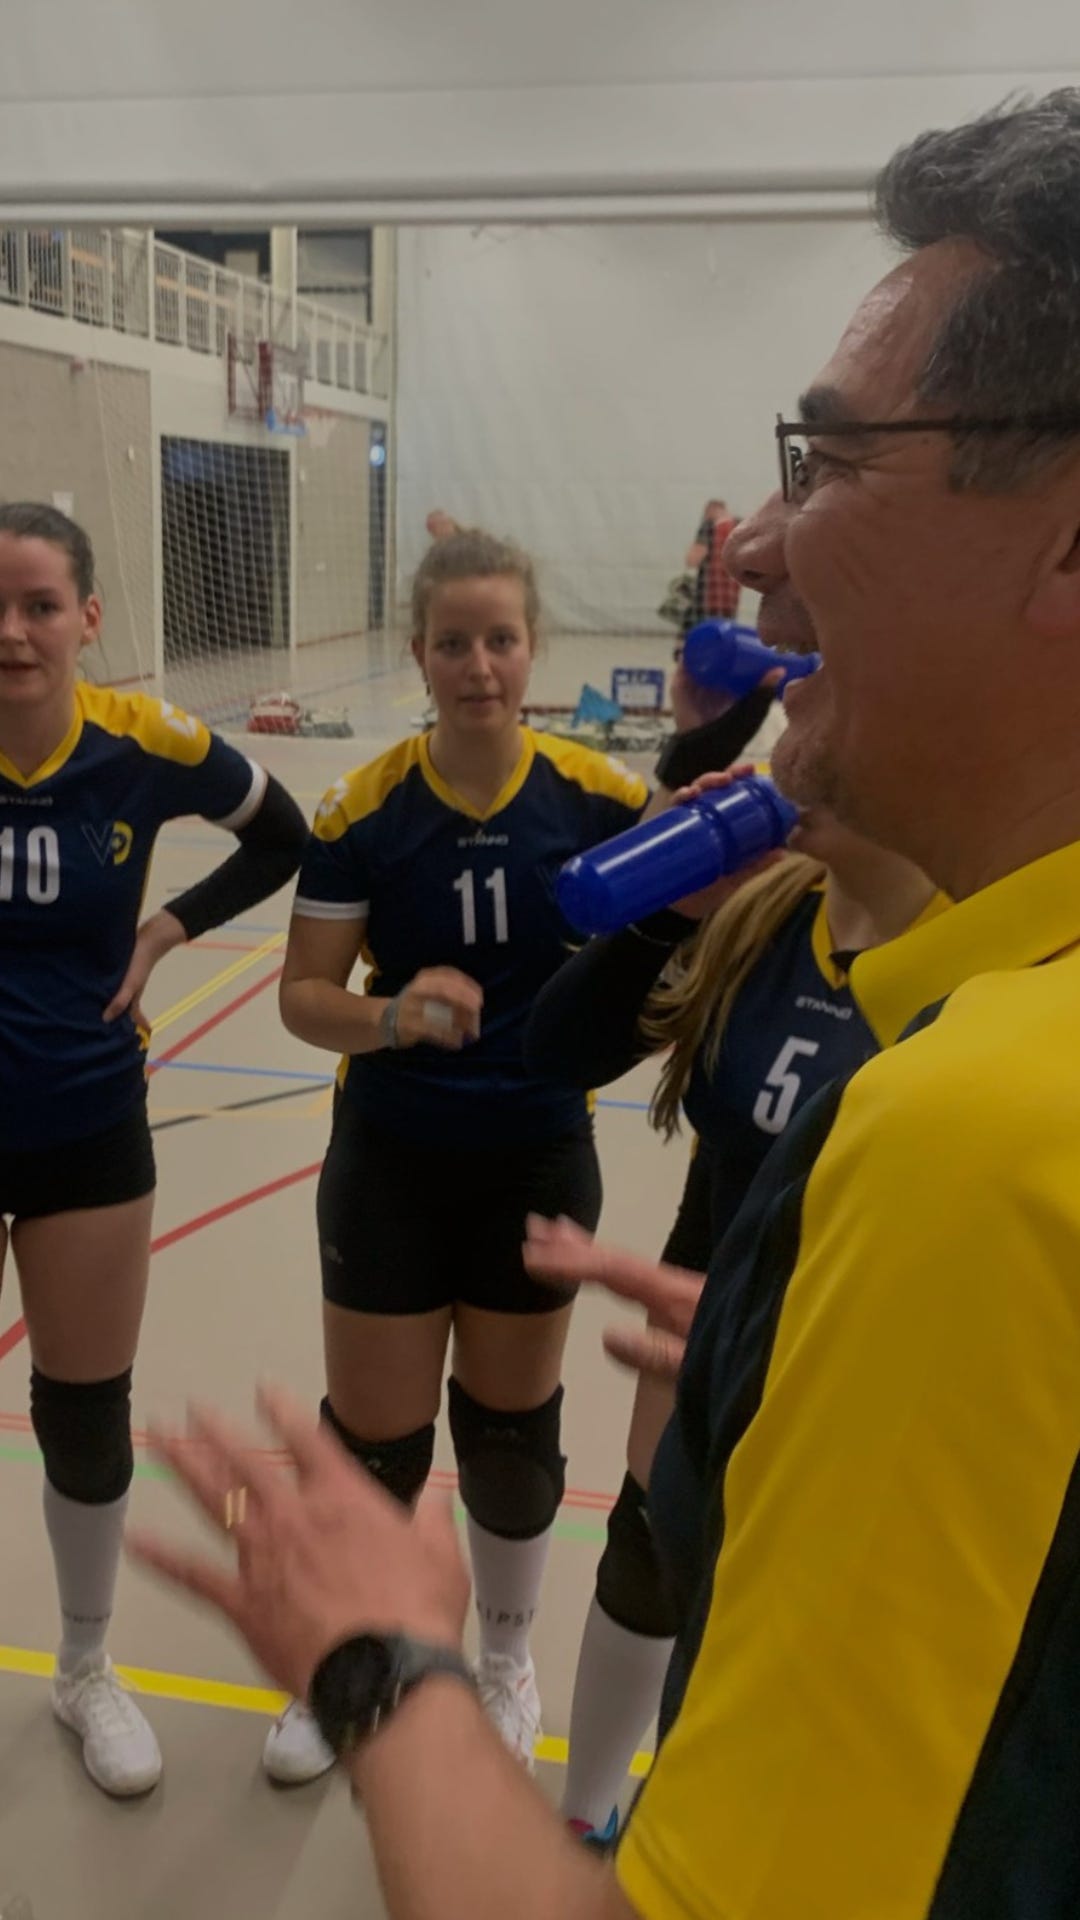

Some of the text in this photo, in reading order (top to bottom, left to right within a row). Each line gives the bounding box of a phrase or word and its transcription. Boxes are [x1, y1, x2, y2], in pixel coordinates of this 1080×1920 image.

[0, 825, 60, 904] 10
[453, 867, 509, 945] 11
[795, 995, 853, 1020] STANNO
[752, 1035, 819, 1135] 5
